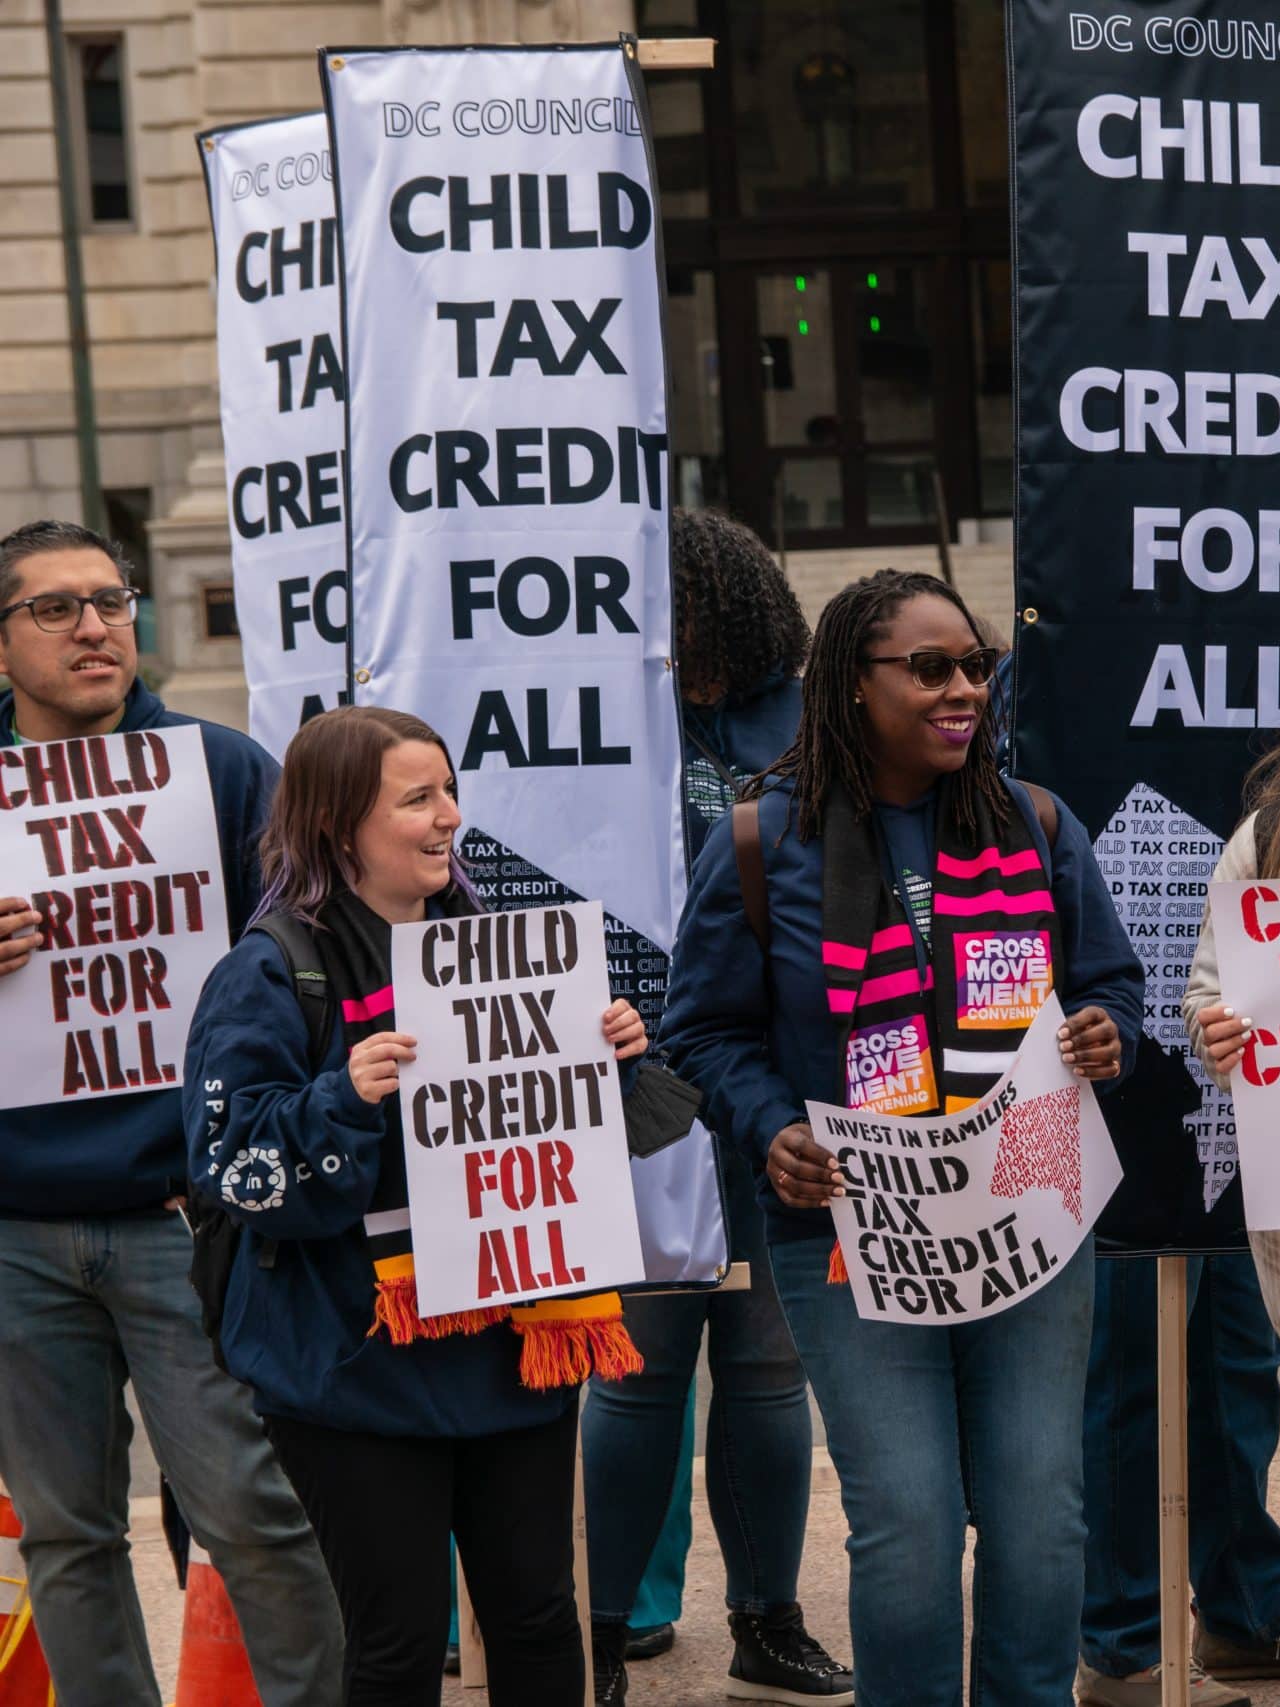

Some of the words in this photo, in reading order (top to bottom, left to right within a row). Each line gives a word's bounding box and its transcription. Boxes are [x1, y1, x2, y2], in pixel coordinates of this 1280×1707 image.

[1069, 13, 1133, 53] DC
[383, 101, 440, 138] DC
[232, 162, 270, 201] DC
[389, 171, 652, 253] CHILD
[437, 298, 627, 378] TAX
[388, 426, 668, 513] CREDIT
[232, 449, 346, 539] CRE
[448, 556, 639, 639] FOR
[460, 686, 631, 771] ALL
[0, 732, 170, 811] CHILD
[1131, 820, 1165, 835] TAX
[1132, 799, 1165, 814] TAX
[26, 804, 157, 878] TAX
[465, 843, 497, 857] TAX
[1130, 841, 1163, 855] TAX
[1168, 842, 1228, 855] CREDIT
[502, 881, 559, 895] CREDIT
[1128, 882, 1162, 896] TAX
[1129, 861, 1163, 876] TAX
[31, 870, 211, 952] REDIT
[604, 919, 632, 934] ALL
[1127, 902, 1161, 917] TAX
[1127, 923, 1160, 937] TAX
[421, 908, 578, 988] CHILD
[607, 960, 633, 973] ALL
[965, 937, 1046, 958] CROSS
[51, 946, 172, 1023] FOR
[966, 958, 1048, 982] MOVE
[967, 981, 1048, 1006] MENT
[453, 989, 560, 1064] TAX
[848, 1025, 919, 1056] ROSS
[63, 1020, 176, 1096] ALL
[848, 1045, 922, 1083] MOVE
[412, 1062, 608, 1149] CREDIT
[850, 1068, 924, 1106] MENT
[826, 1116, 892, 1145] INVEST
[900, 1128, 923, 1148] IN
[927, 1080, 1017, 1148] FAMILIES
[245, 1172, 262, 1190] in
[464, 1139, 578, 1220] FOR
[837, 1146, 969, 1196] CHILD
[845, 1188, 932, 1236] TAX
[477, 1220, 585, 1299] ALL
[858, 1212, 1020, 1276] CREDIT
[867, 1273, 968, 1315] FOR
[981, 1237, 1058, 1308] ALL
